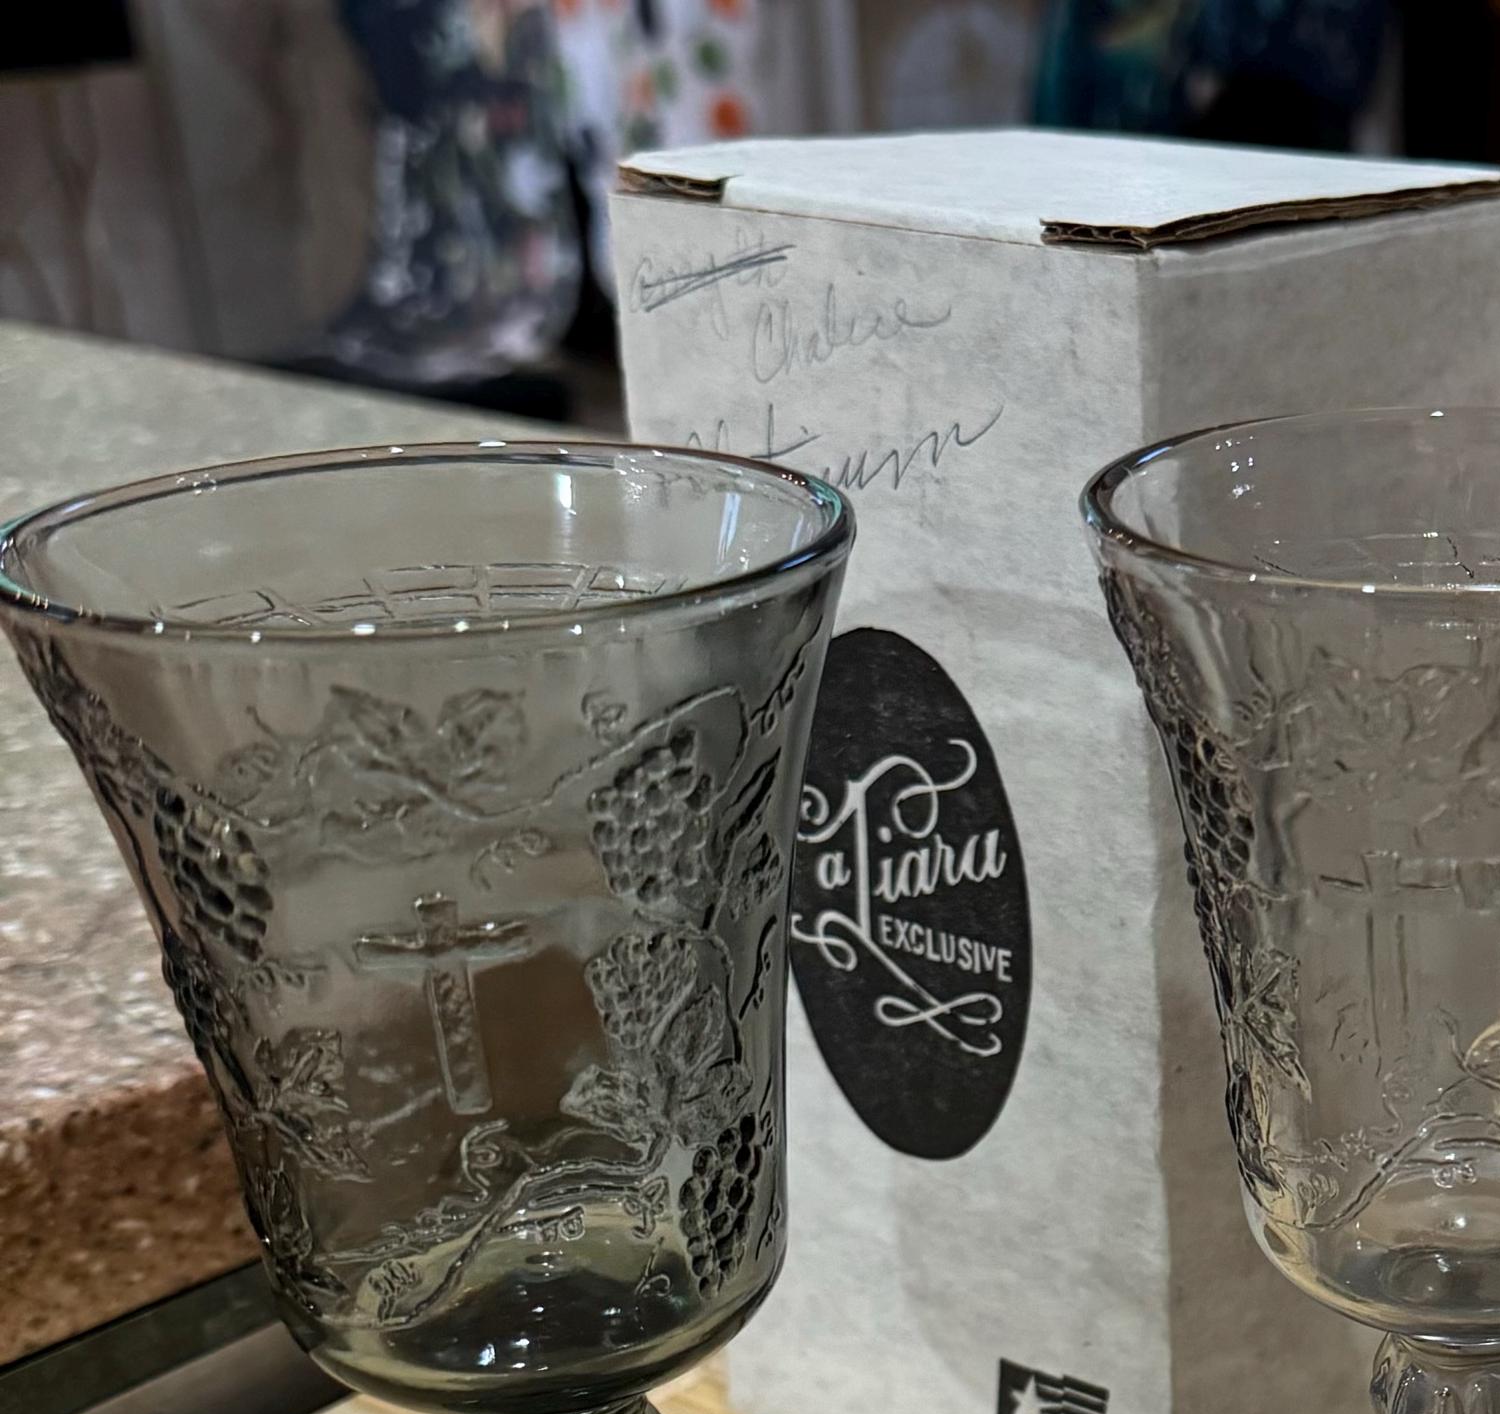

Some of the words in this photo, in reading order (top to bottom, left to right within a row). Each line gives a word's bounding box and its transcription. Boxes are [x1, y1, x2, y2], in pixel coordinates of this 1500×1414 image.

[797, 740, 1007, 930] Tiara
[818, 852, 850, 889] a
[877, 914, 1012, 982] EXCLUSIVE
